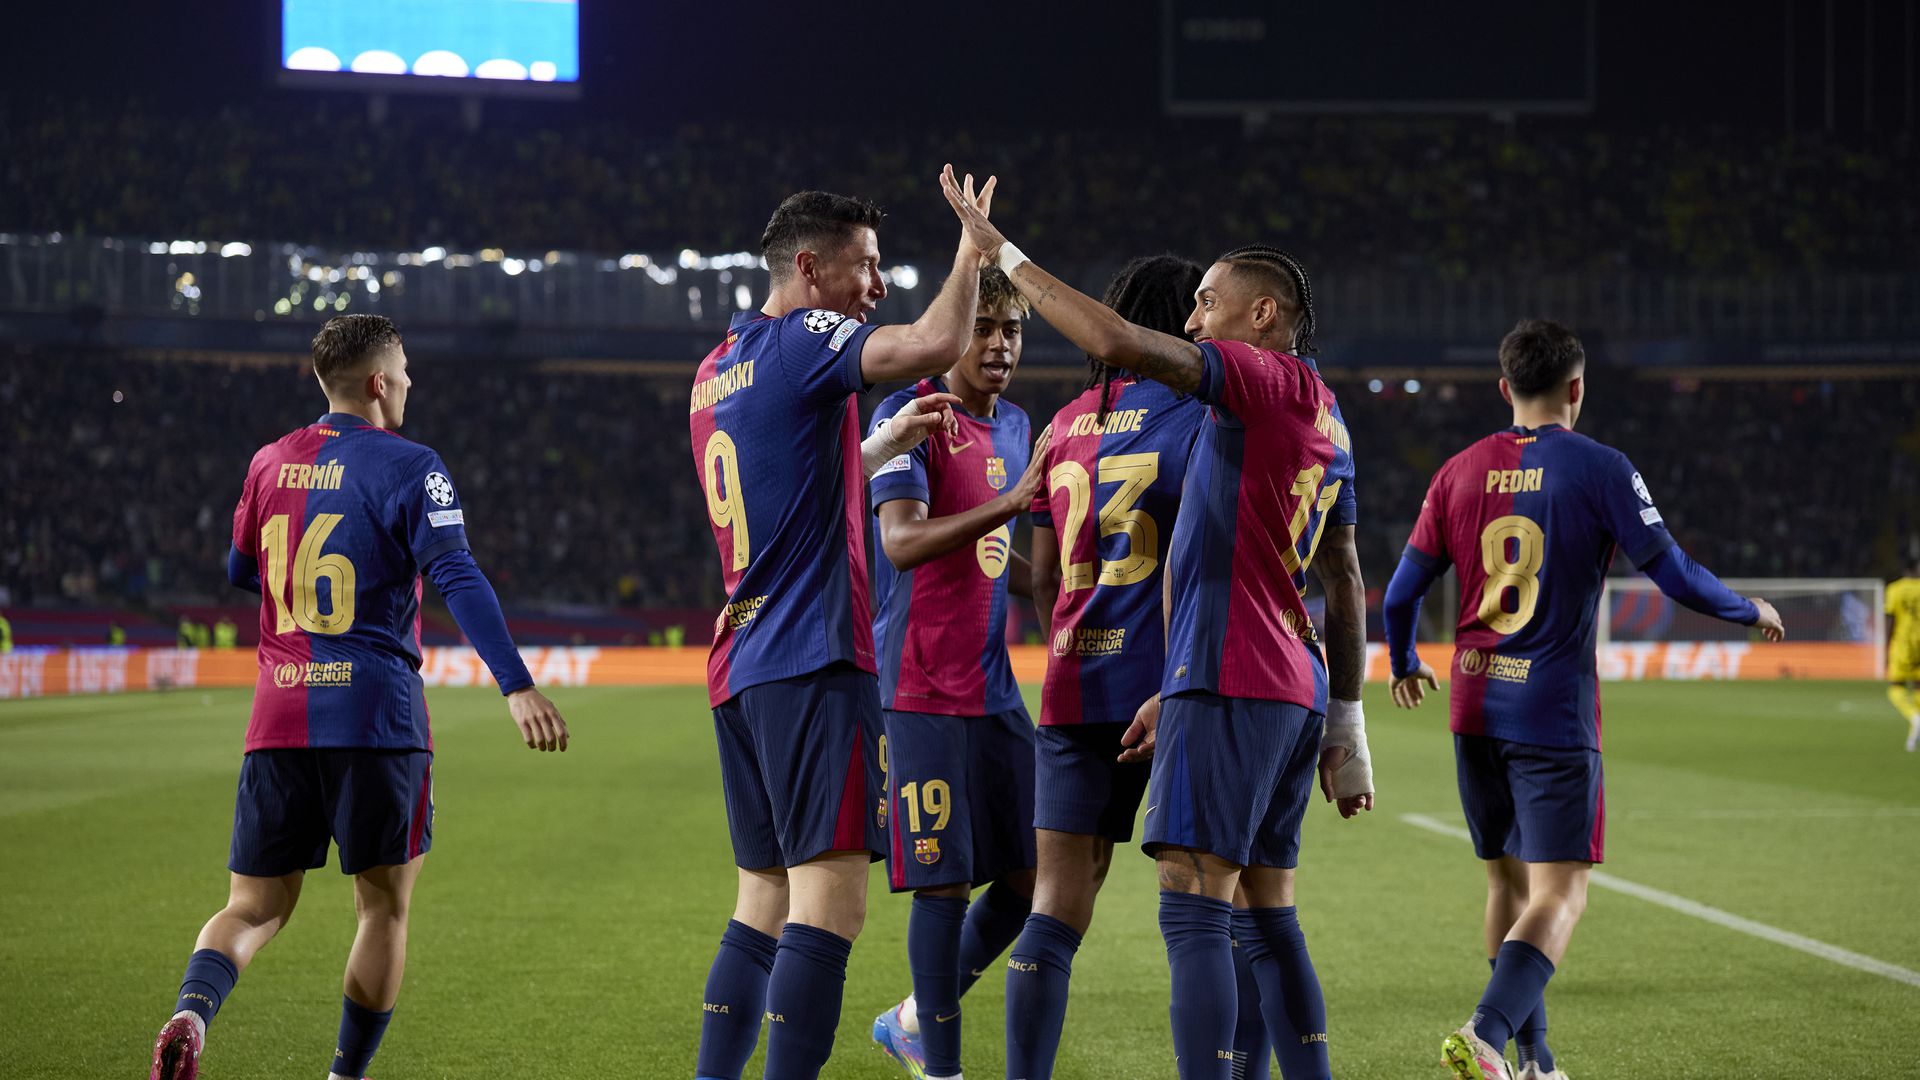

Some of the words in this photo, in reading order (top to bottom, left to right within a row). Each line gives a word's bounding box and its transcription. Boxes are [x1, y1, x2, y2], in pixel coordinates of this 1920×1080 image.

[276, 458, 345, 490] FERMÍN
[1485, 467, 1544, 494] PEDRI
[704, 430, 750, 573] 9
[1050, 451, 1160, 593] 23
[260, 513, 356, 635] 16
[1476, 515, 1545, 635] 8
[1075, 638, 1123, 652] ACNUR
[1076, 628, 1126, 640] UNHCR
[305, 661, 353, 673] UNHCR
[420, 646, 497, 686] UST
[1486, 664, 1529, 680] ACNUR
[1489, 653, 1532, 670] UNHCR
[1599, 641, 1657, 681] ST
[1663, 641, 1751, 681] EAT
[303, 671, 352, 682] ACNUR
[901, 779, 951, 833] 19
[703, 1002, 729, 1014] ARÇA
